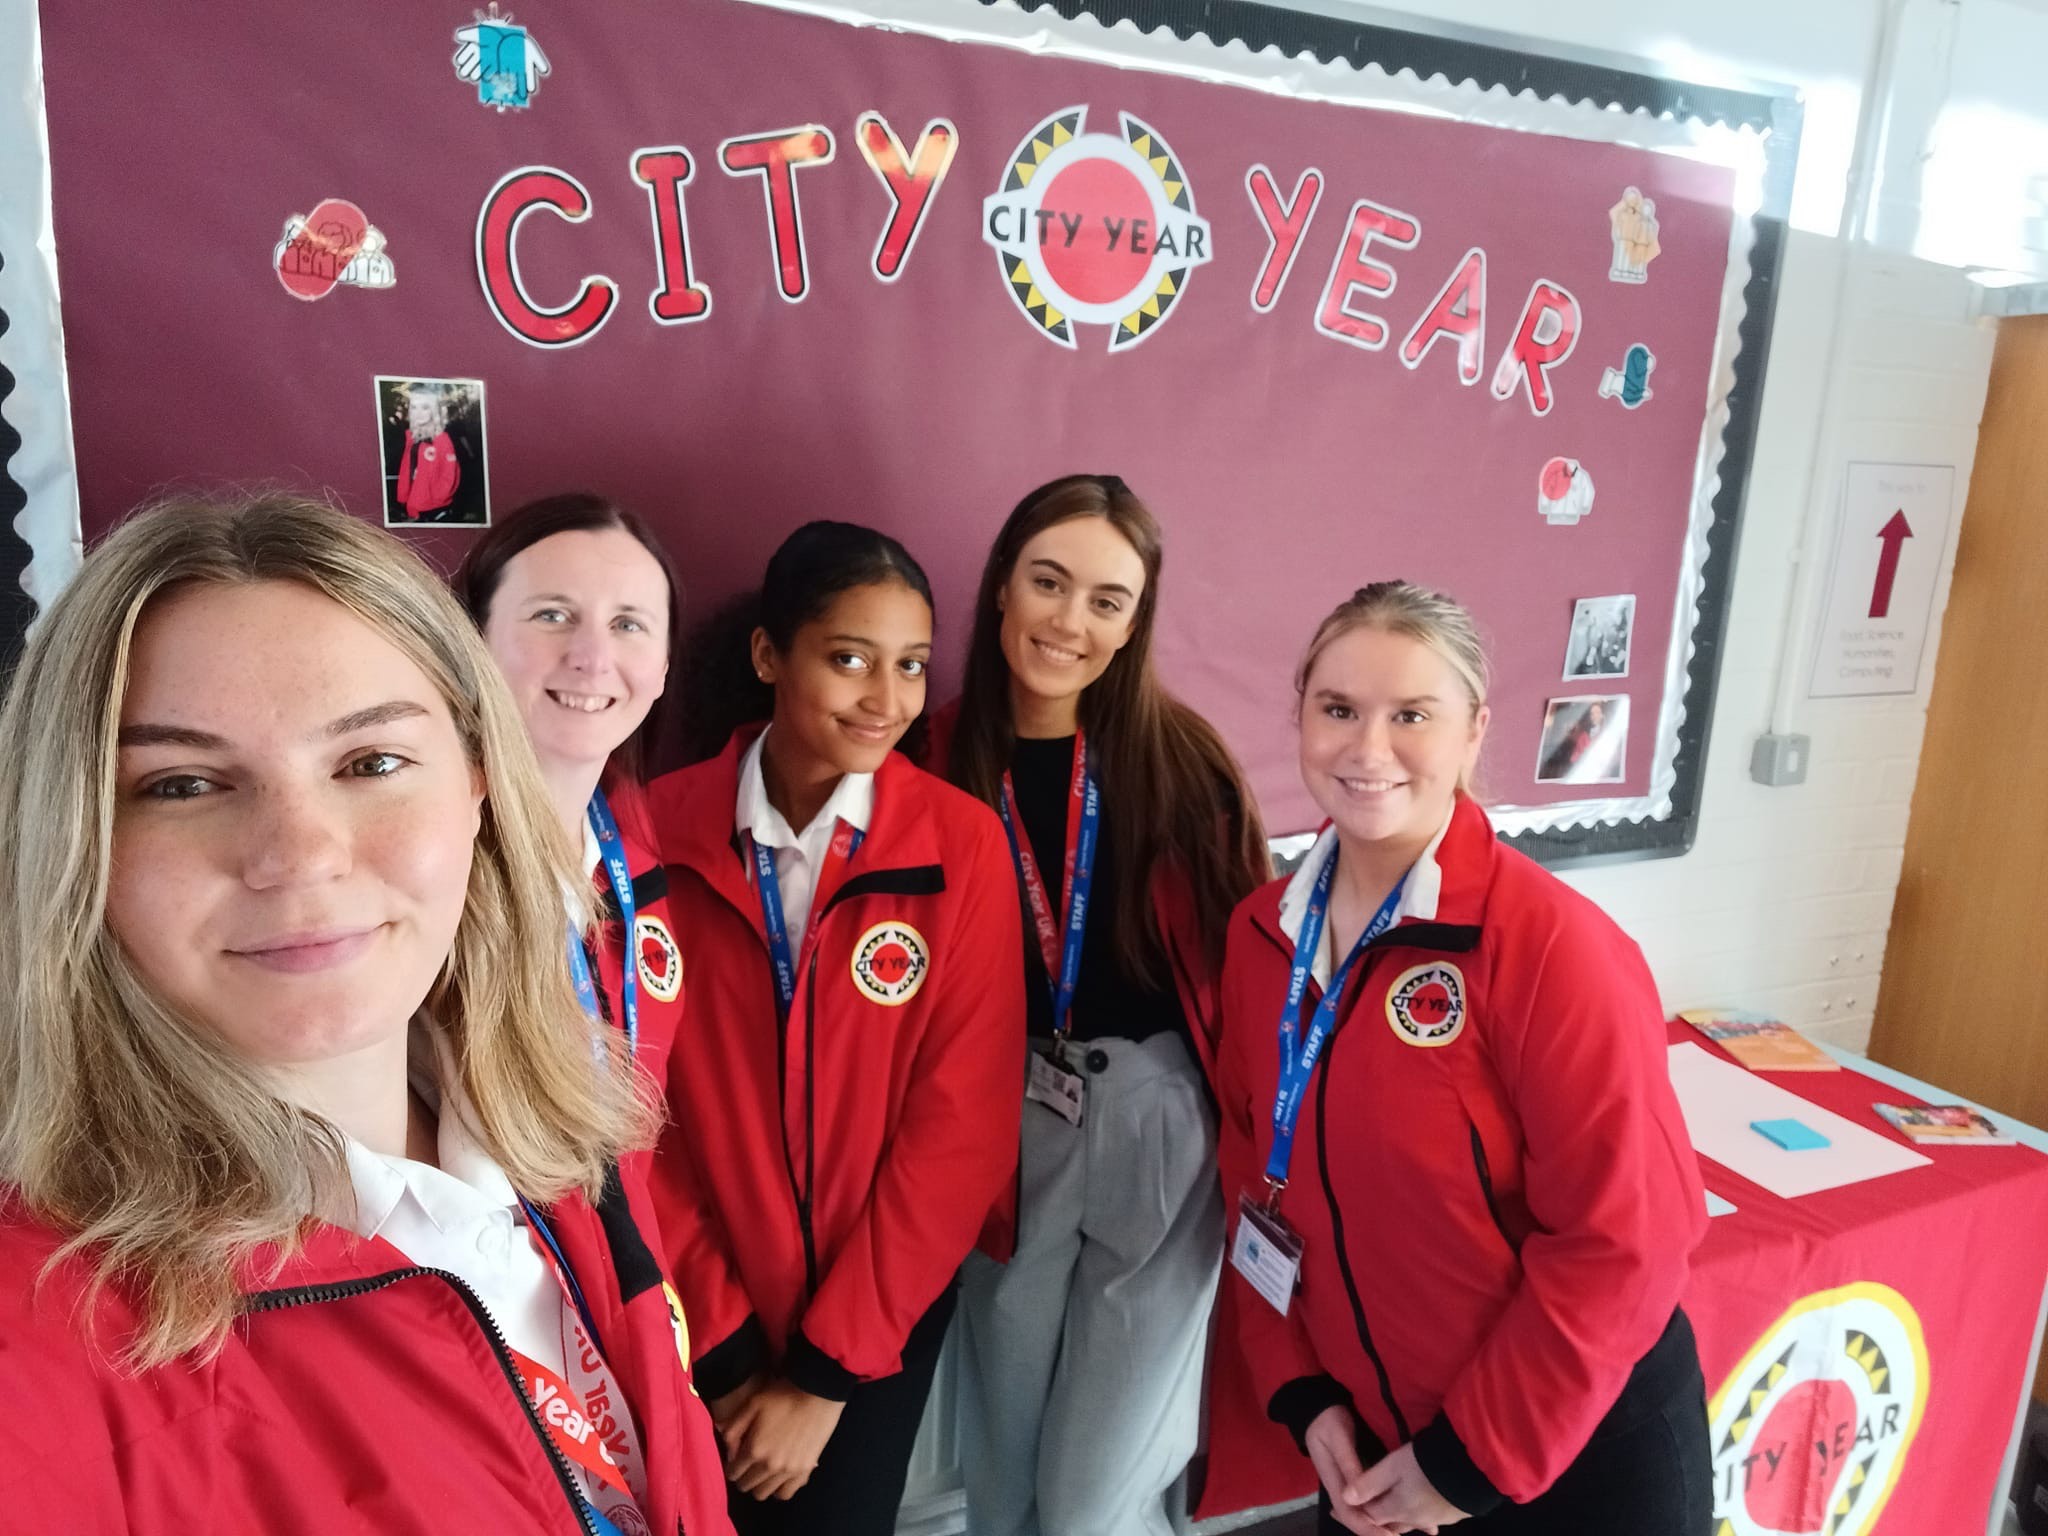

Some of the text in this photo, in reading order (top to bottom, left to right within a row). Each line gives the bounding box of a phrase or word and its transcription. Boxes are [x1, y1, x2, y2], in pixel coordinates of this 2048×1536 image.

[989, 205, 1206, 258] CITY YEAR
[477, 111, 1582, 416] CITY YEAR
[756, 844, 773, 877] STAF
[609, 858, 633, 905] STAFF
[1071, 892, 1086, 931] STAFF
[1361, 909, 1391, 947] STAFF
[777, 960, 794, 1001] STAFF
[855, 955, 926, 974] CITY YEAR
[1289, 966, 1307, 1007] STAFF
[1391, 995, 1463, 1013] CITY YEAR
[1301, 1024, 1325, 1070] STAFF
[534, 1376, 596, 1446] Year
[1713, 1402, 1901, 1503] ITY YEAR
